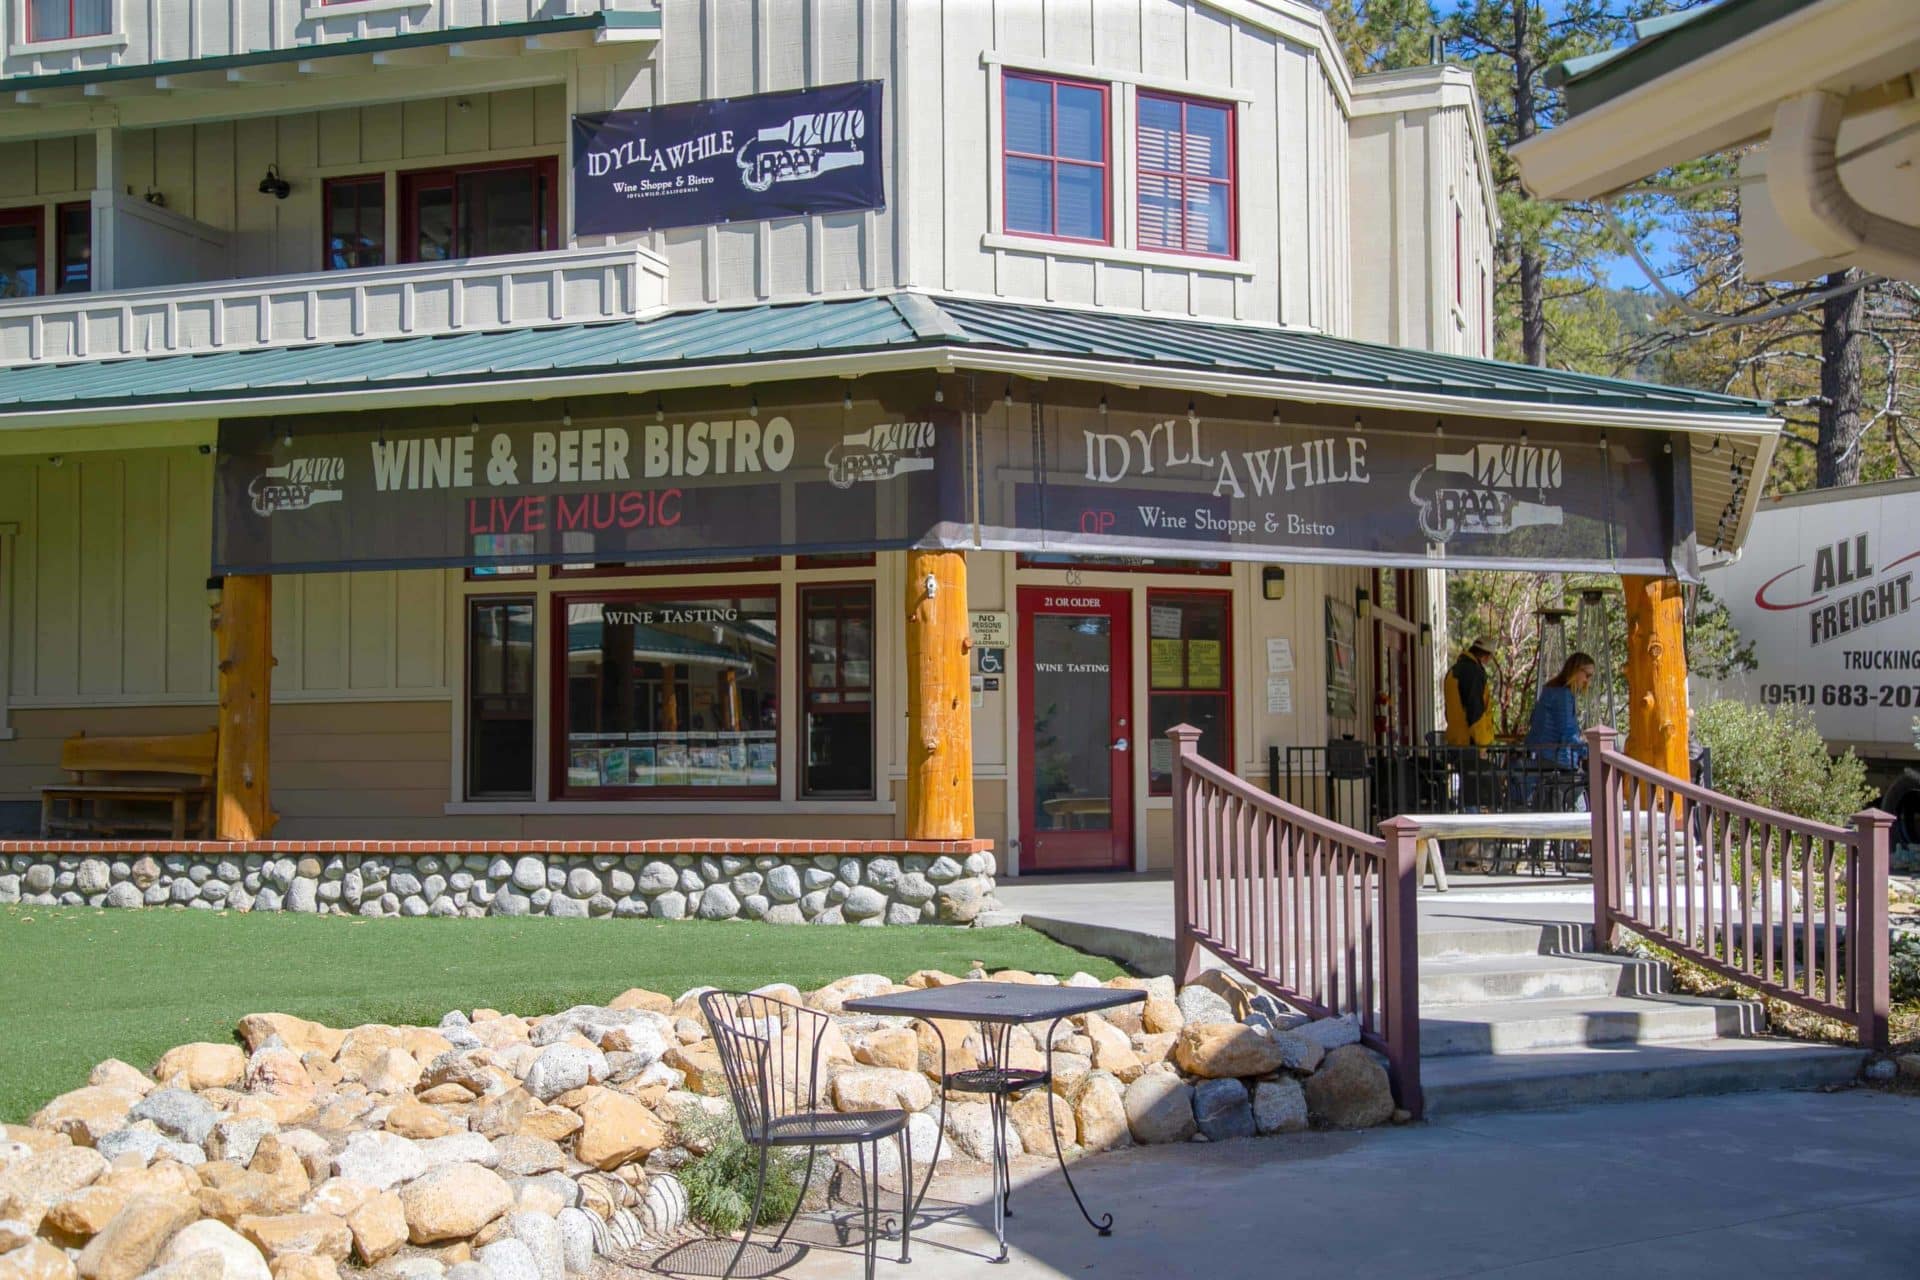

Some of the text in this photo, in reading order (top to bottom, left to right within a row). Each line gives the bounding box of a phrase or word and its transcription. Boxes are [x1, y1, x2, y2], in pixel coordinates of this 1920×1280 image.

[613, 174, 714, 194] Wine Shoppe & Bistro
[370, 416, 795, 492] WINE & BEER BISTRO
[468, 488, 683, 535] LIVE MUSIC
[1138, 505, 1336, 537] Wine Shoppe & Bistro
[1812, 532, 1873, 595] ALL
[1044, 597, 1101, 608] 21 OR OLDER
[1809, 571, 1913, 647] FREIGHT
[605, 608, 738, 625] WINE TASTING
[978, 614, 996, 622] NO
[1035, 662, 1110, 673] WINE TASTING
[1842, 650, 1920, 670] TRUCKING
[1760, 684, 1815, 705] (951)
